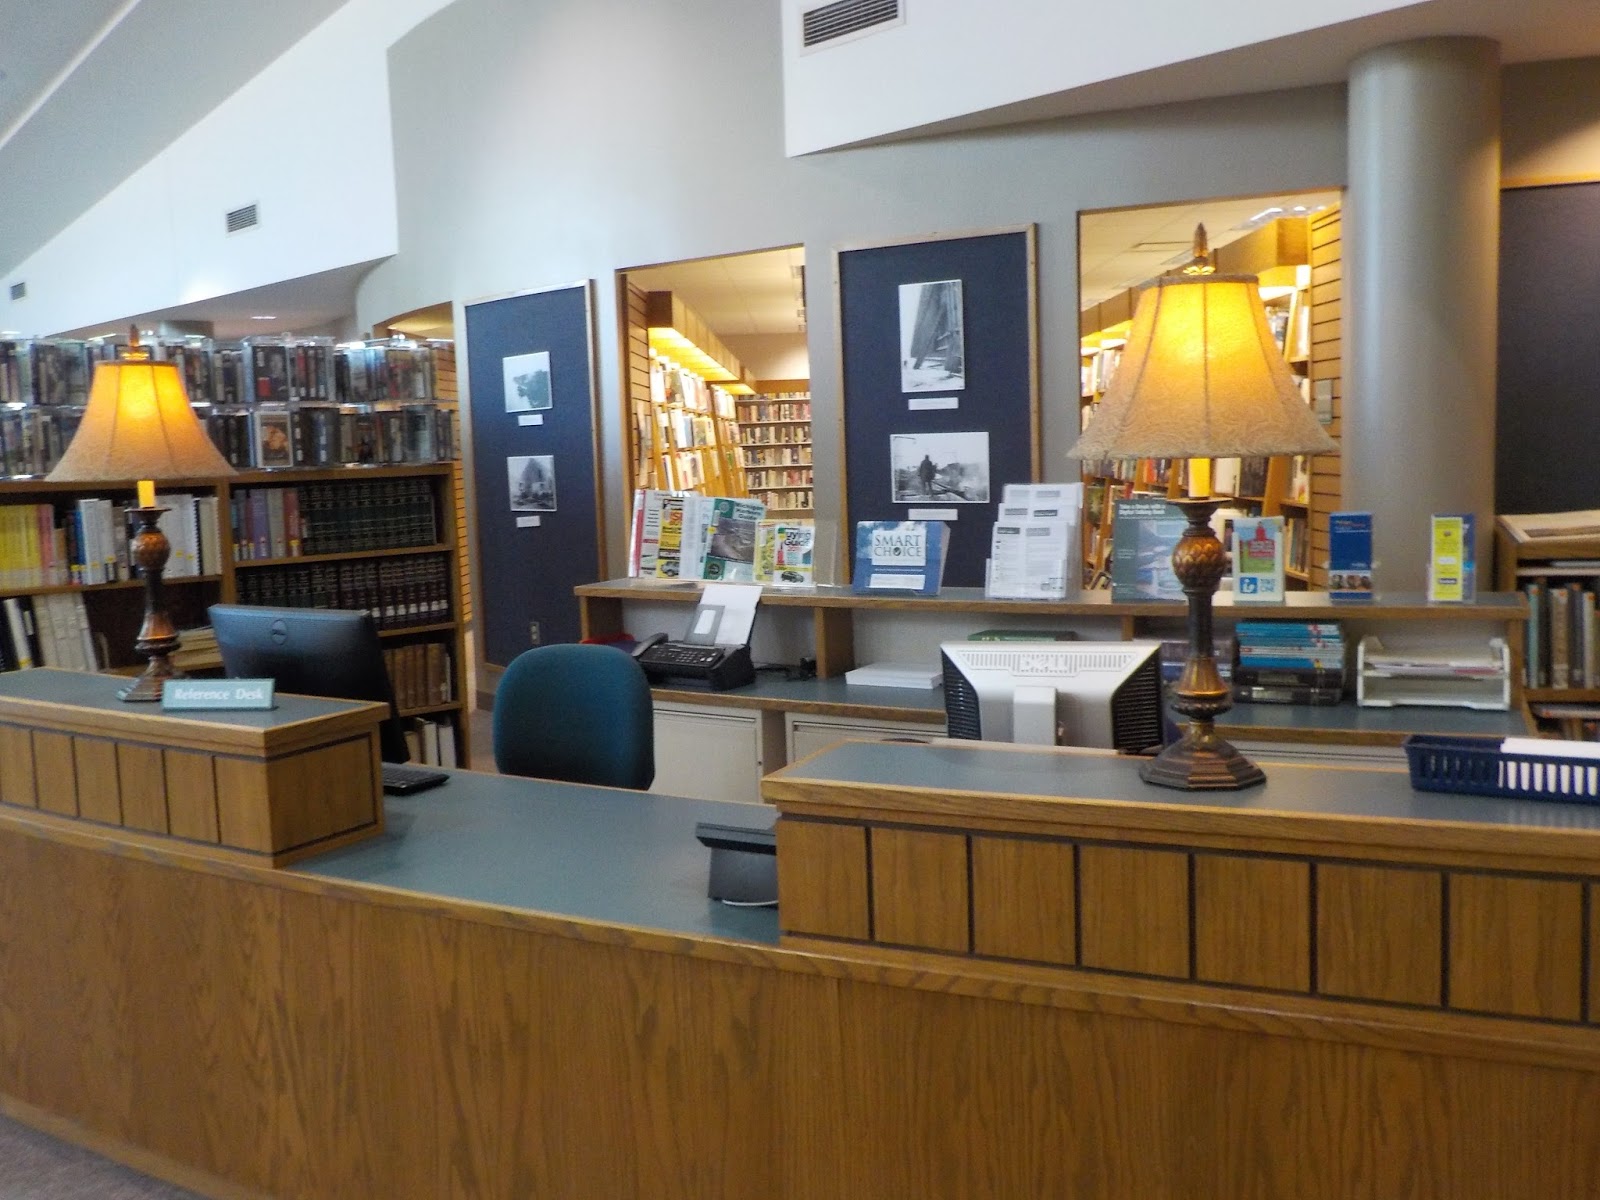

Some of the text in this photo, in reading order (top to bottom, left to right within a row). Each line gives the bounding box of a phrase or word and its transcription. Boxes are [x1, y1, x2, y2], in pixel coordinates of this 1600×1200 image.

[786, 531, 811, 541] uying
[874, 534, 922, 547] SMART
[873, 547, 922, 557] CHOICE
[174, 688, 264, 700] Reference Desk
